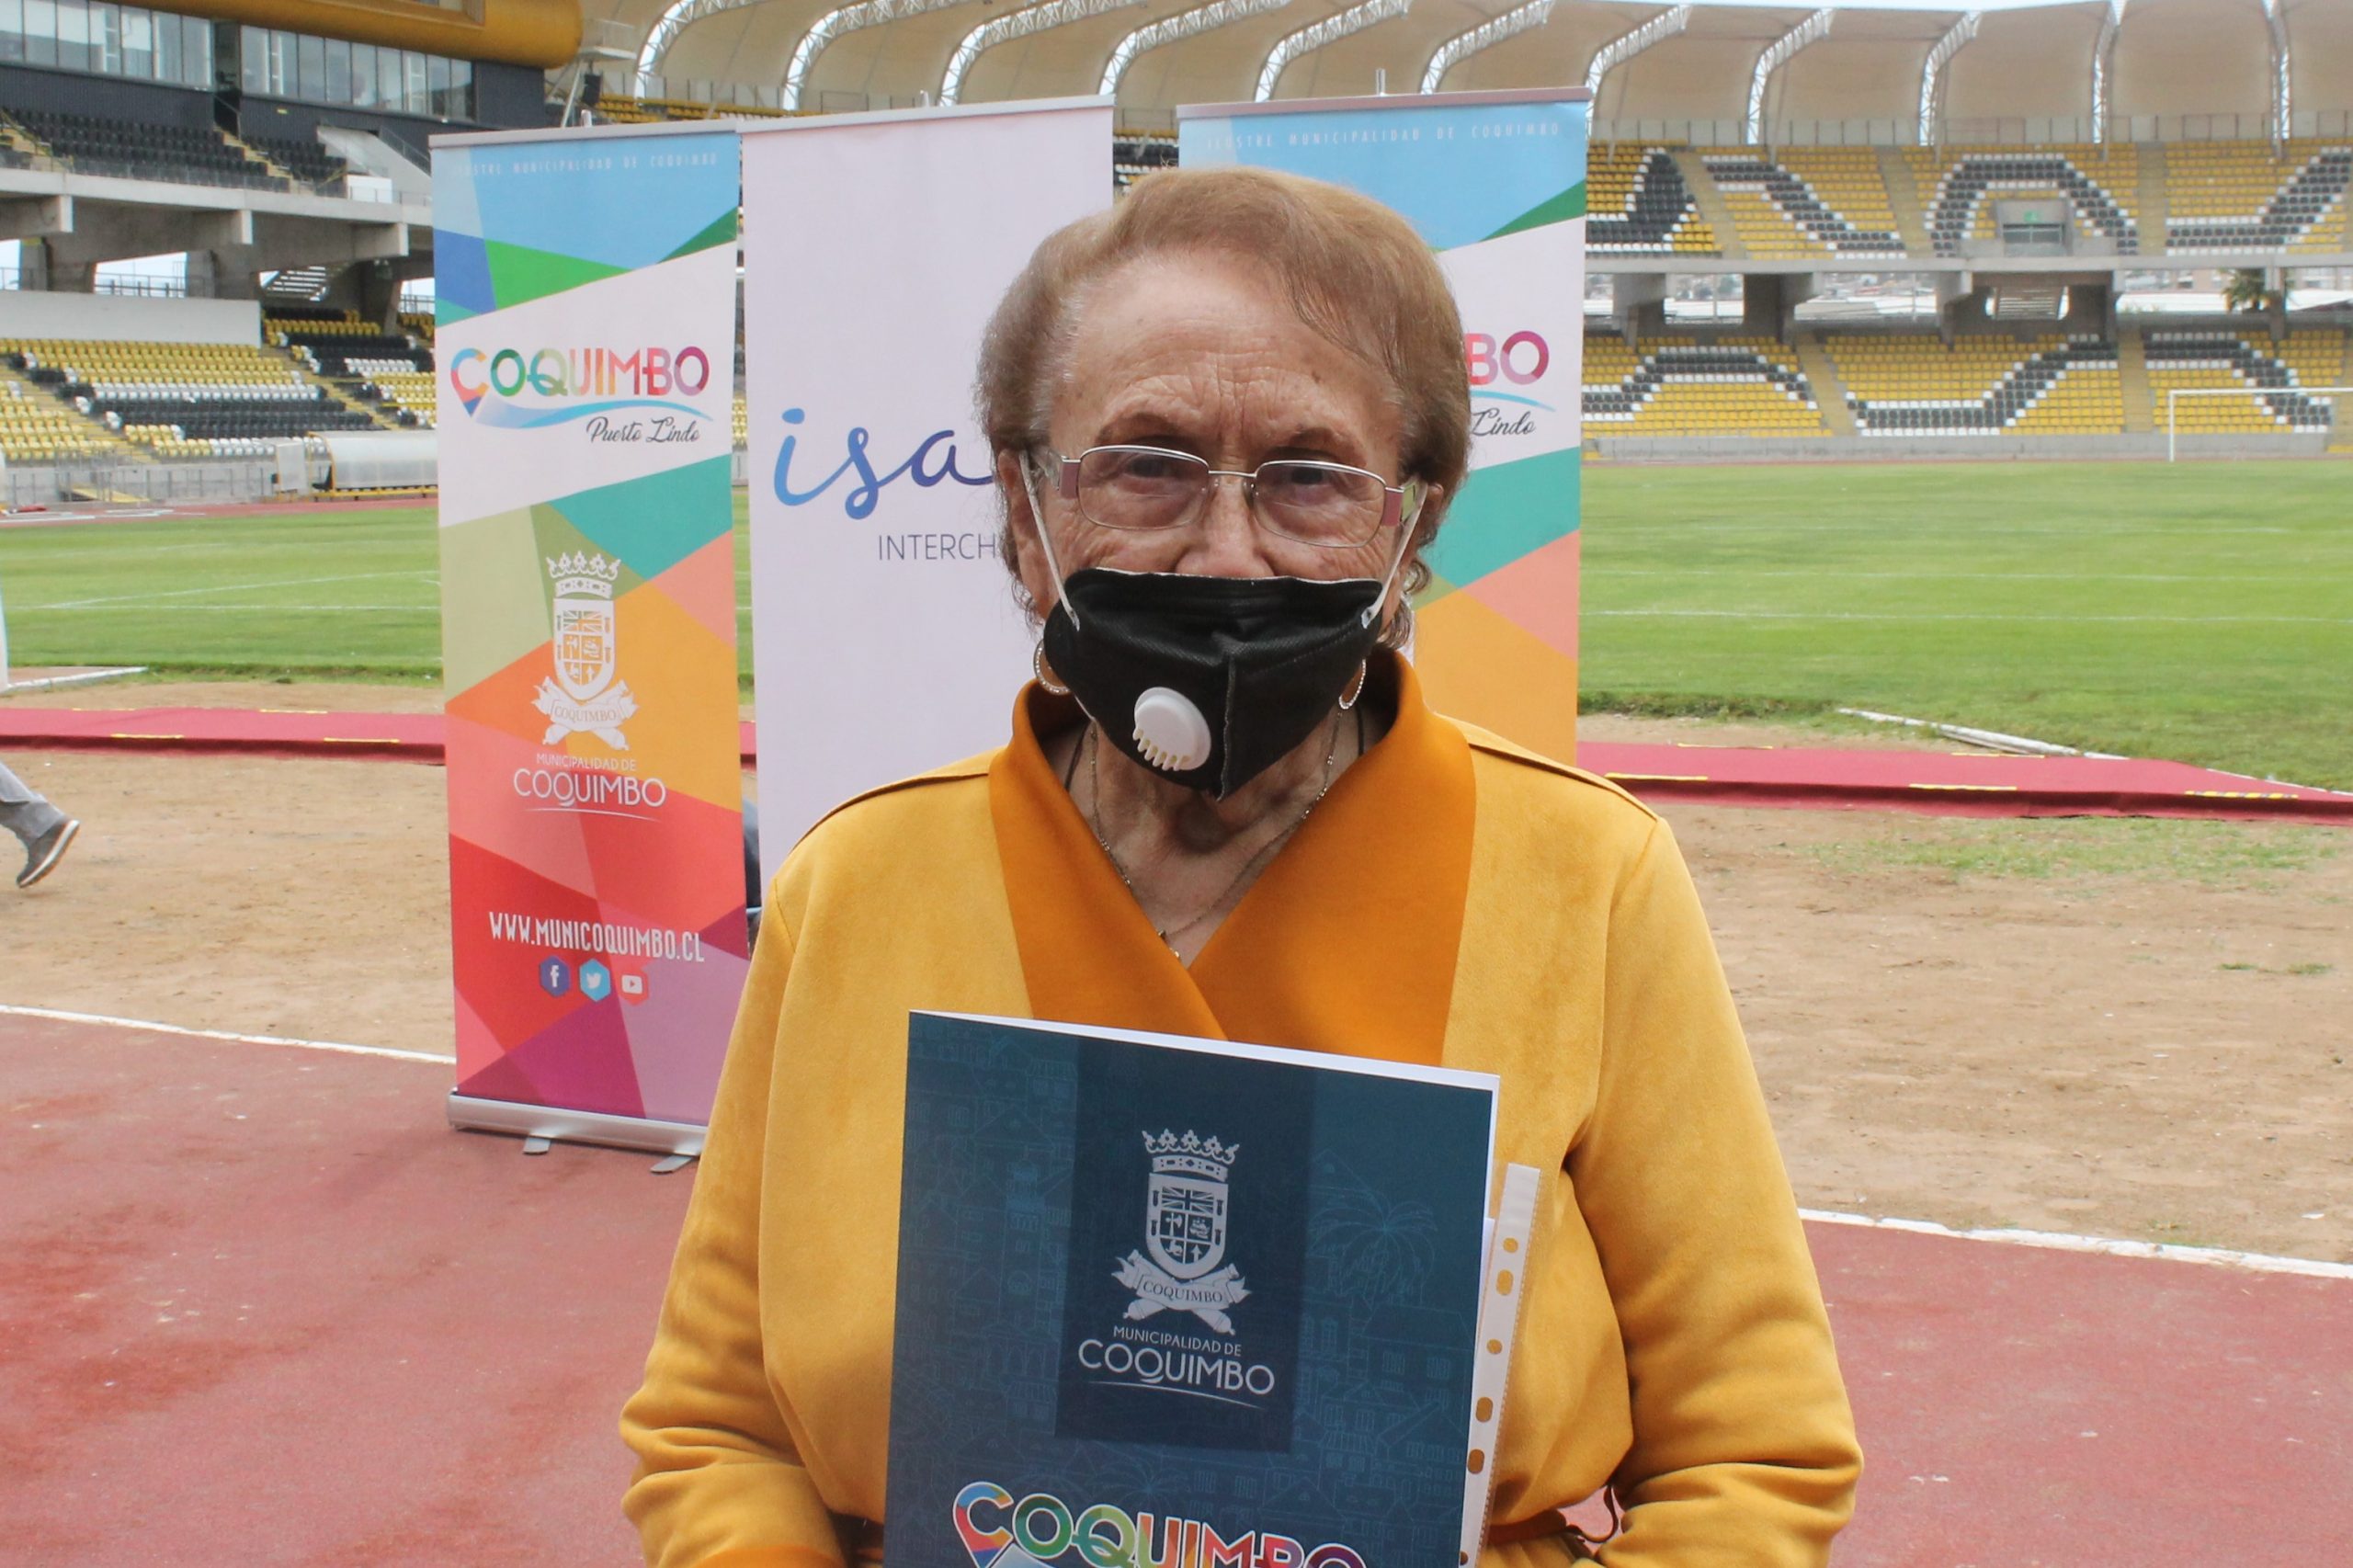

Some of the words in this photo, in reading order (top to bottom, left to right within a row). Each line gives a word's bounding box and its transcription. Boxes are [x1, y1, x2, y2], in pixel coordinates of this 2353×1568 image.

[1289, 129, 1421, 147] MUNICIPALIDAD
[1437, 127, 1456, 141] DE
[1471, 122, 1560, 140] COQUIMBO
[450, 346, 710, 417] COQUIMBO
[585, 416, 643, 444] Puerto
[645, 416, 701, 444] Lindo
[1471, 407, 1536, 437] Lindo
[553, 705, 618, 723] COQUIMBO
[536, 753, 619, 771] MUNICIPALIDAD
[620, 758, 637, 771] DE
[513, 768, 666, 807] COQUIMBO
[488, 911, 705, 963] WWW.MUNICOQUIMBO.CL
[1142, 1274, 1223, 1303] COQUIMBO
[1113, 1325, 1222, 1354] MUNICIPALIDAD
[1223, 1343, 1242, 1358] DE
[1078, 1339, 1275, 1395] COQUIMBO
